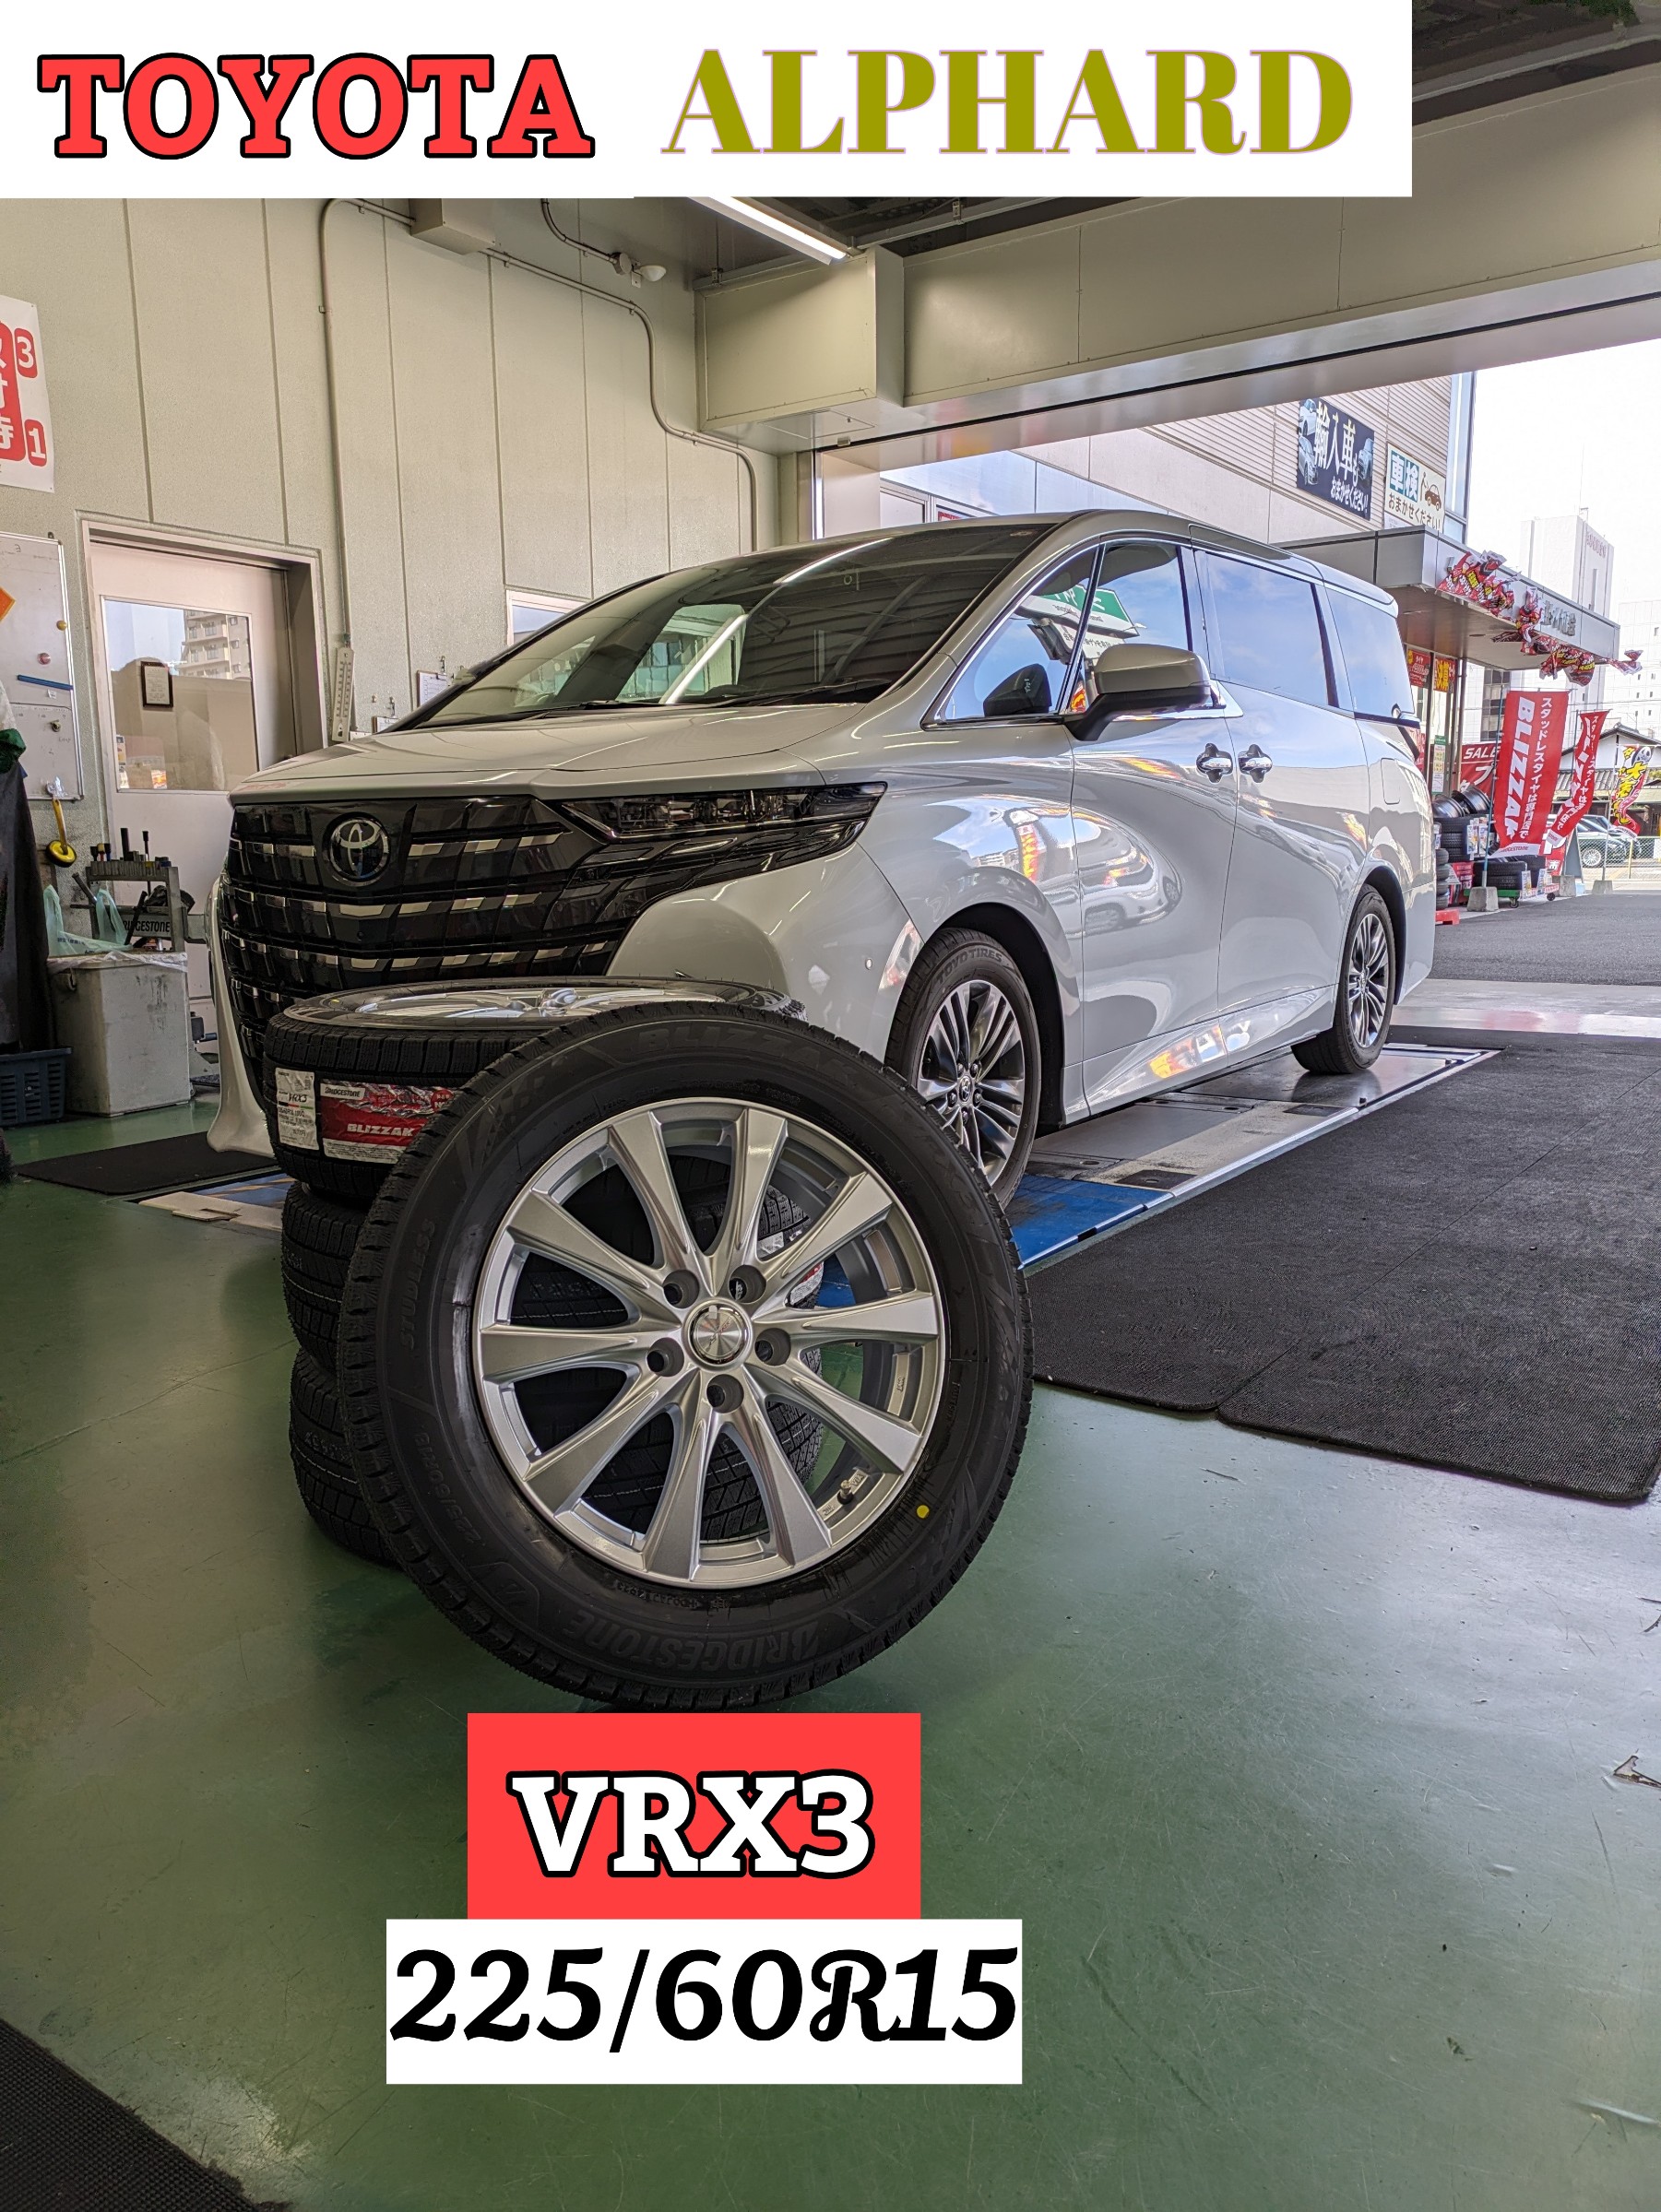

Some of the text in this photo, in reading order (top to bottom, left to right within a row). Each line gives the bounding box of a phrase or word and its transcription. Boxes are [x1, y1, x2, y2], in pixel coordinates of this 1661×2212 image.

[17, 336, 34, 369] 3
[29, 428, 46, 459] 1
[1391, 453, 1419, 502] 車検
[1463, 746, 1501, 759] SALE
[1504, 696, 1536, 840] BLIZZAK
[123, 920, 171, 932] RIGESTONE
[934, 948, 1003, 984] TOYO TIRES
[324, 1086, 361, 1098] BRIDGESTONE
[346, 1123, 416, 1137] BLIZZAK
[398, 1217, 436, 1351] STUDLESS
[563, 1609, 820, 1672] BRIDGESTONE
